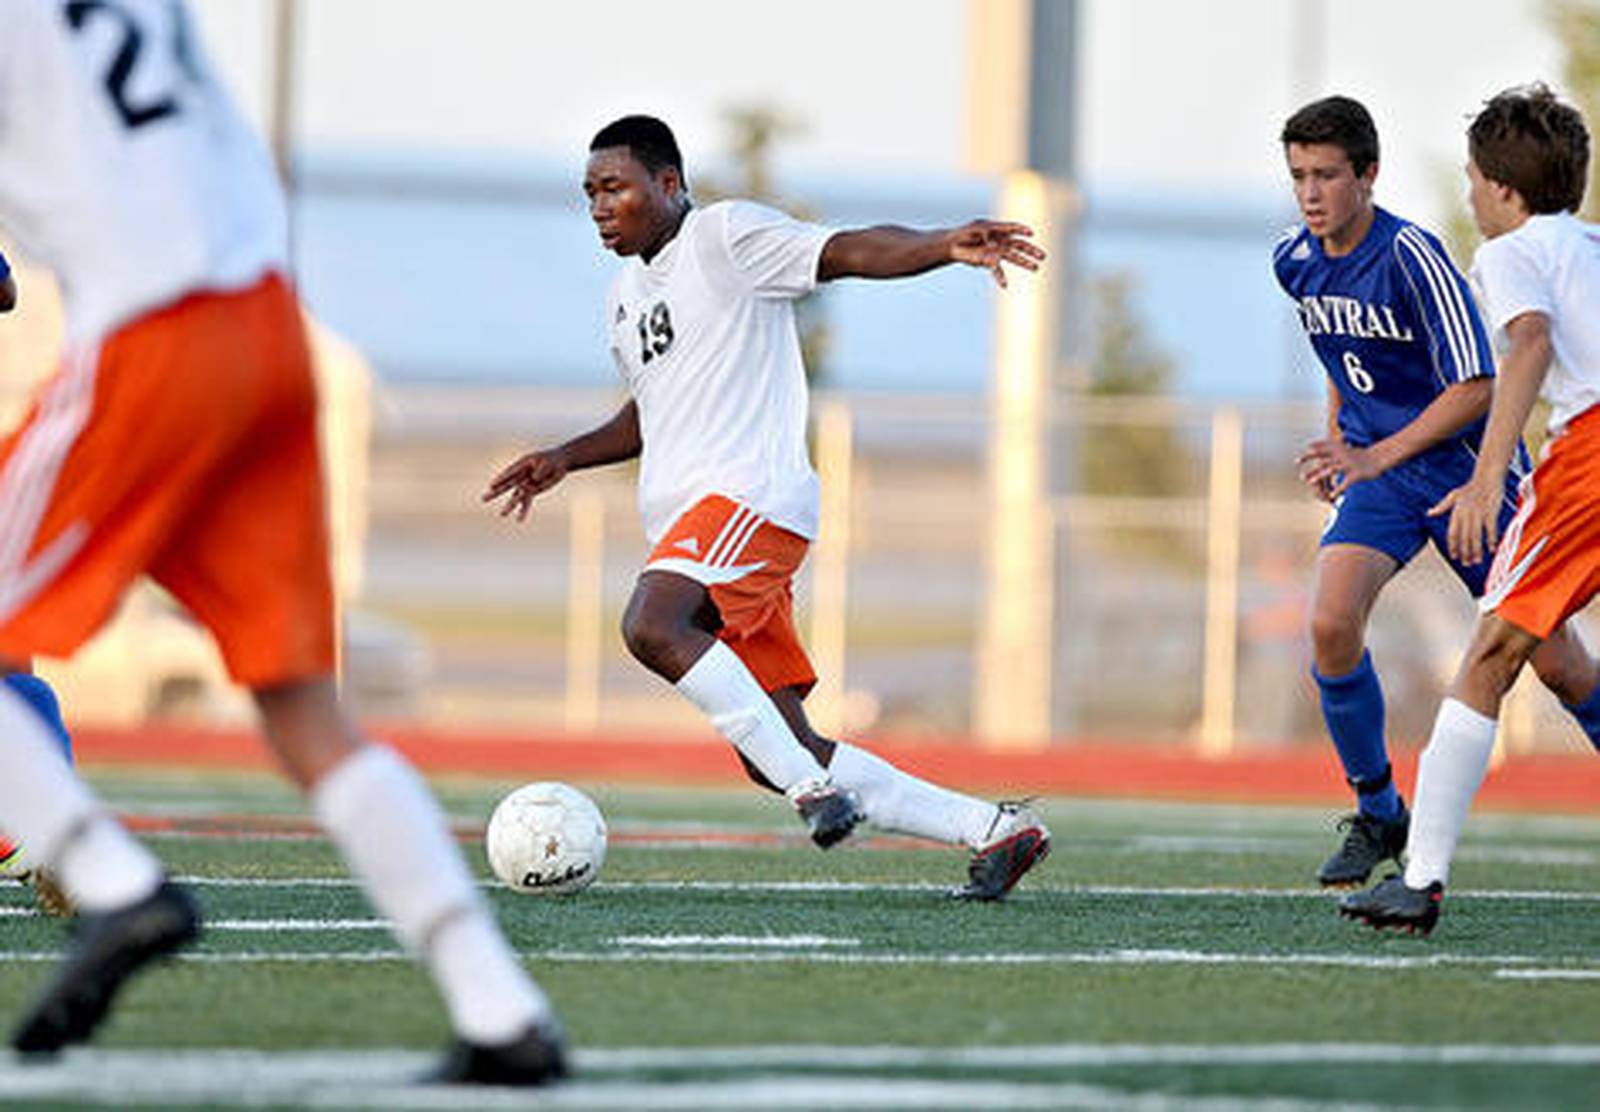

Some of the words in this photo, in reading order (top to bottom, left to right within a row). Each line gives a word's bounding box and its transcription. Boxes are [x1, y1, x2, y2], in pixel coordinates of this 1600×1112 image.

[636, 301, 675, 366] 19
[1299, 294, 1414, 342] ENTRAL
[1342, 350, 1375, 394] 6
